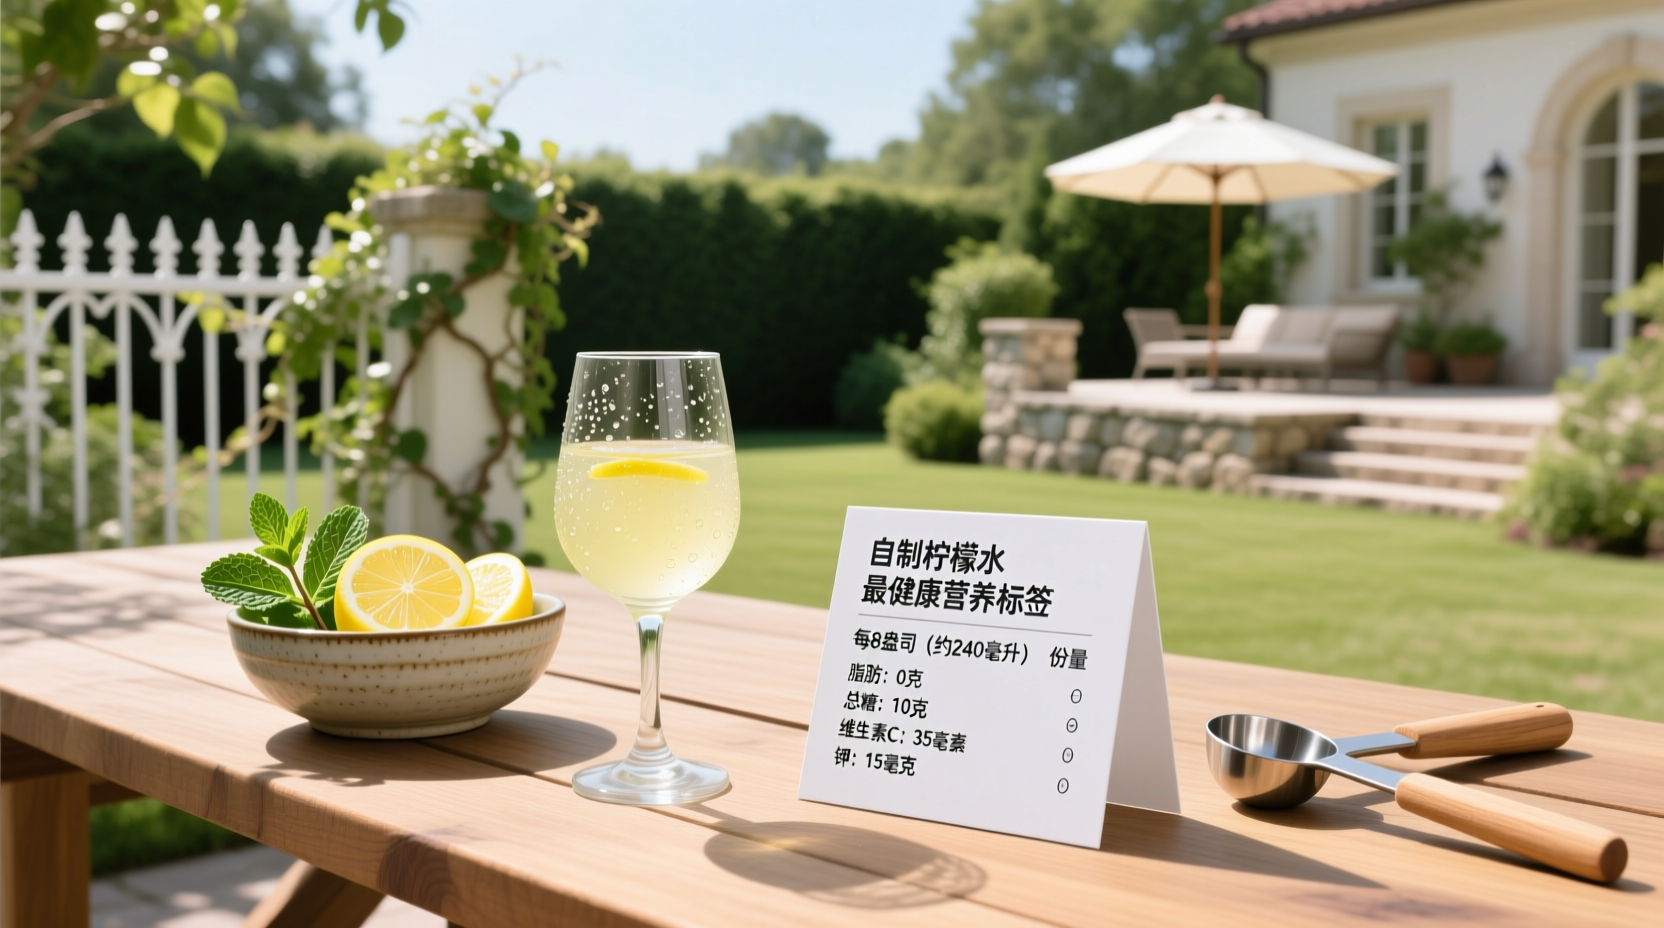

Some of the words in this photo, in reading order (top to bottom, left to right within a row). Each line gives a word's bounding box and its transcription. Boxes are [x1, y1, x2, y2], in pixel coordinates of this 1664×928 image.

[870, 537, 1005, 575] 自制柠檬水
[861, 574, 1055, 618] 最健康营养标签
[1050, 646, 1088, 670] 份量
